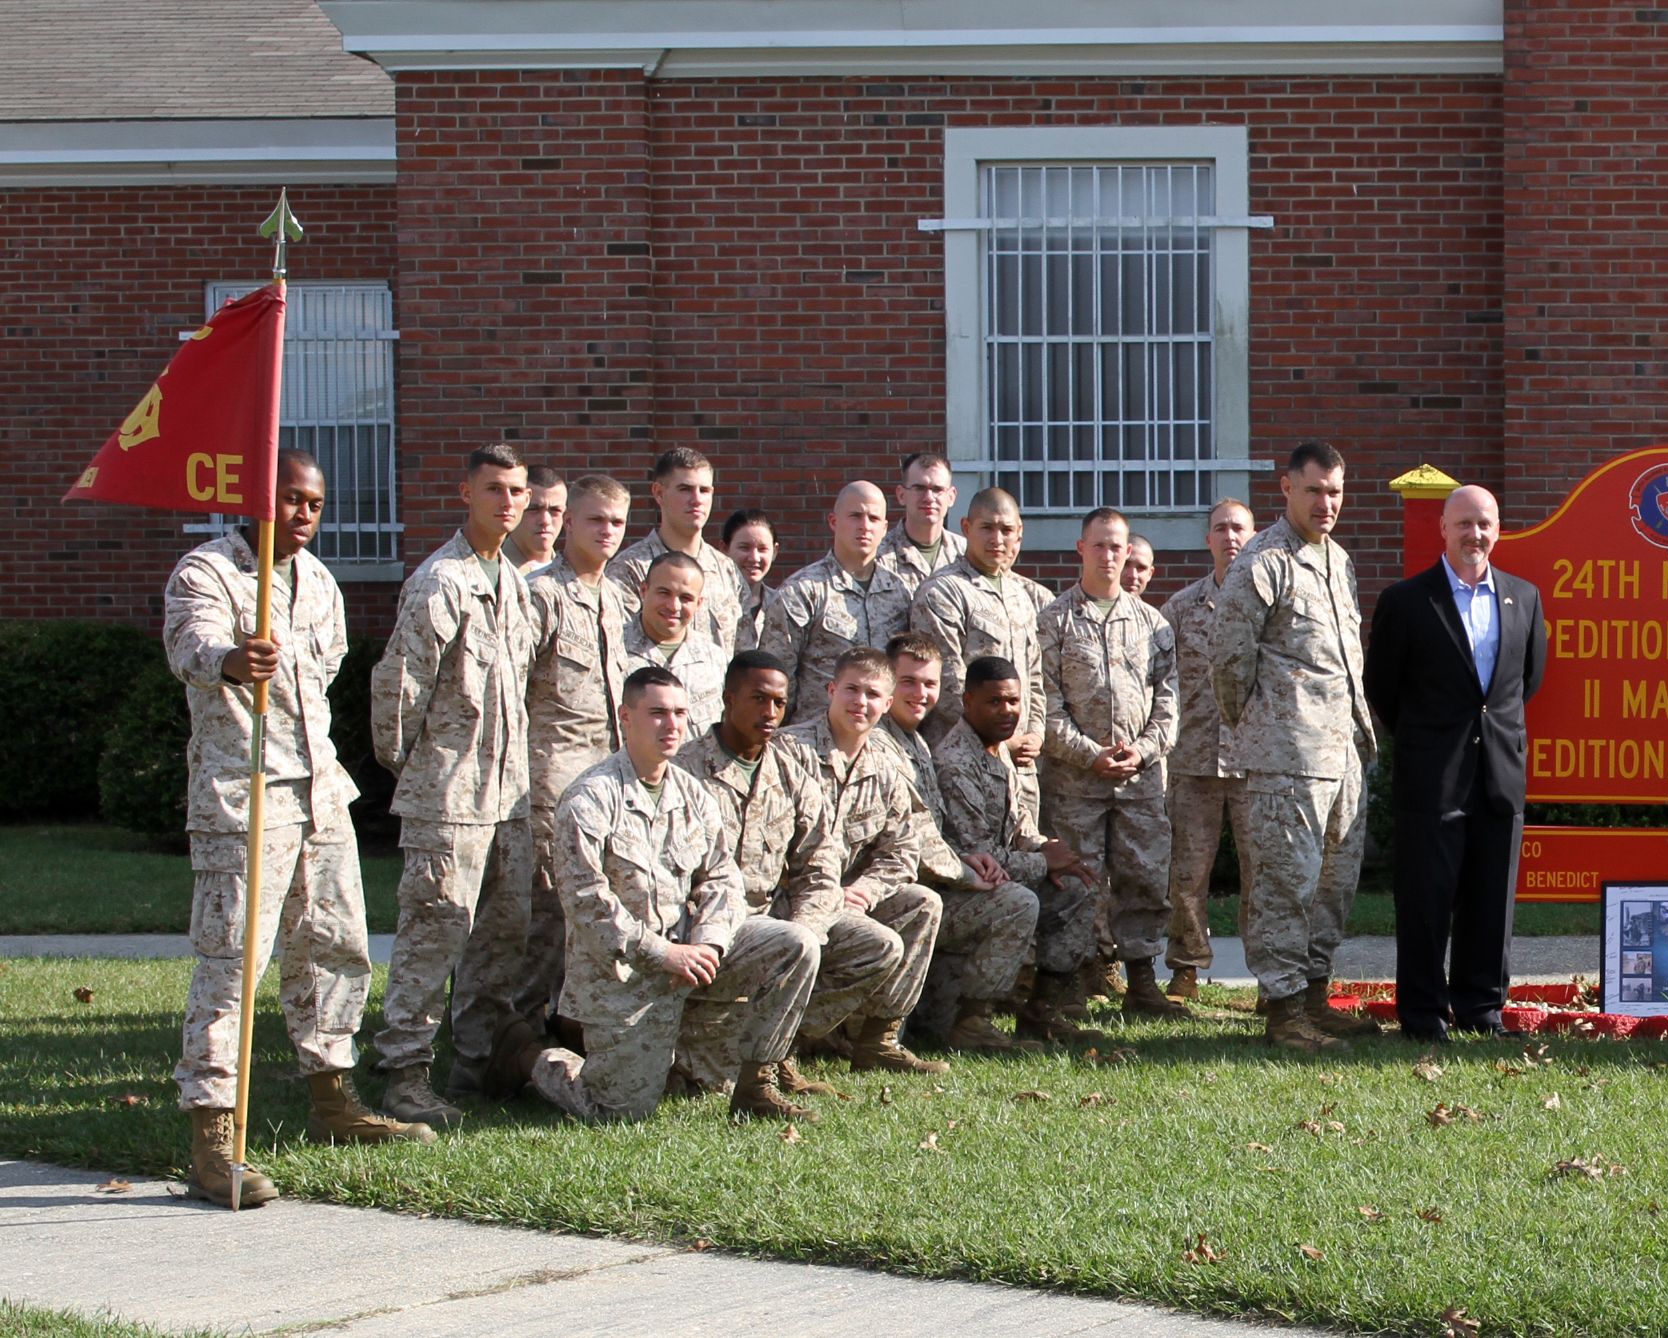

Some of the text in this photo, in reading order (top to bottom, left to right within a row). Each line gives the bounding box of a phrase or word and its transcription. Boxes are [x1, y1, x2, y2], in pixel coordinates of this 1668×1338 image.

[186, 452, 244, 504] CE
[1552, 558, 1640, 599] 24TH
[1584, 679, 1600, 718] II
[1521, 841, 1542, 858] CO
[1526, 871, 1599, 888] BENEDICT
